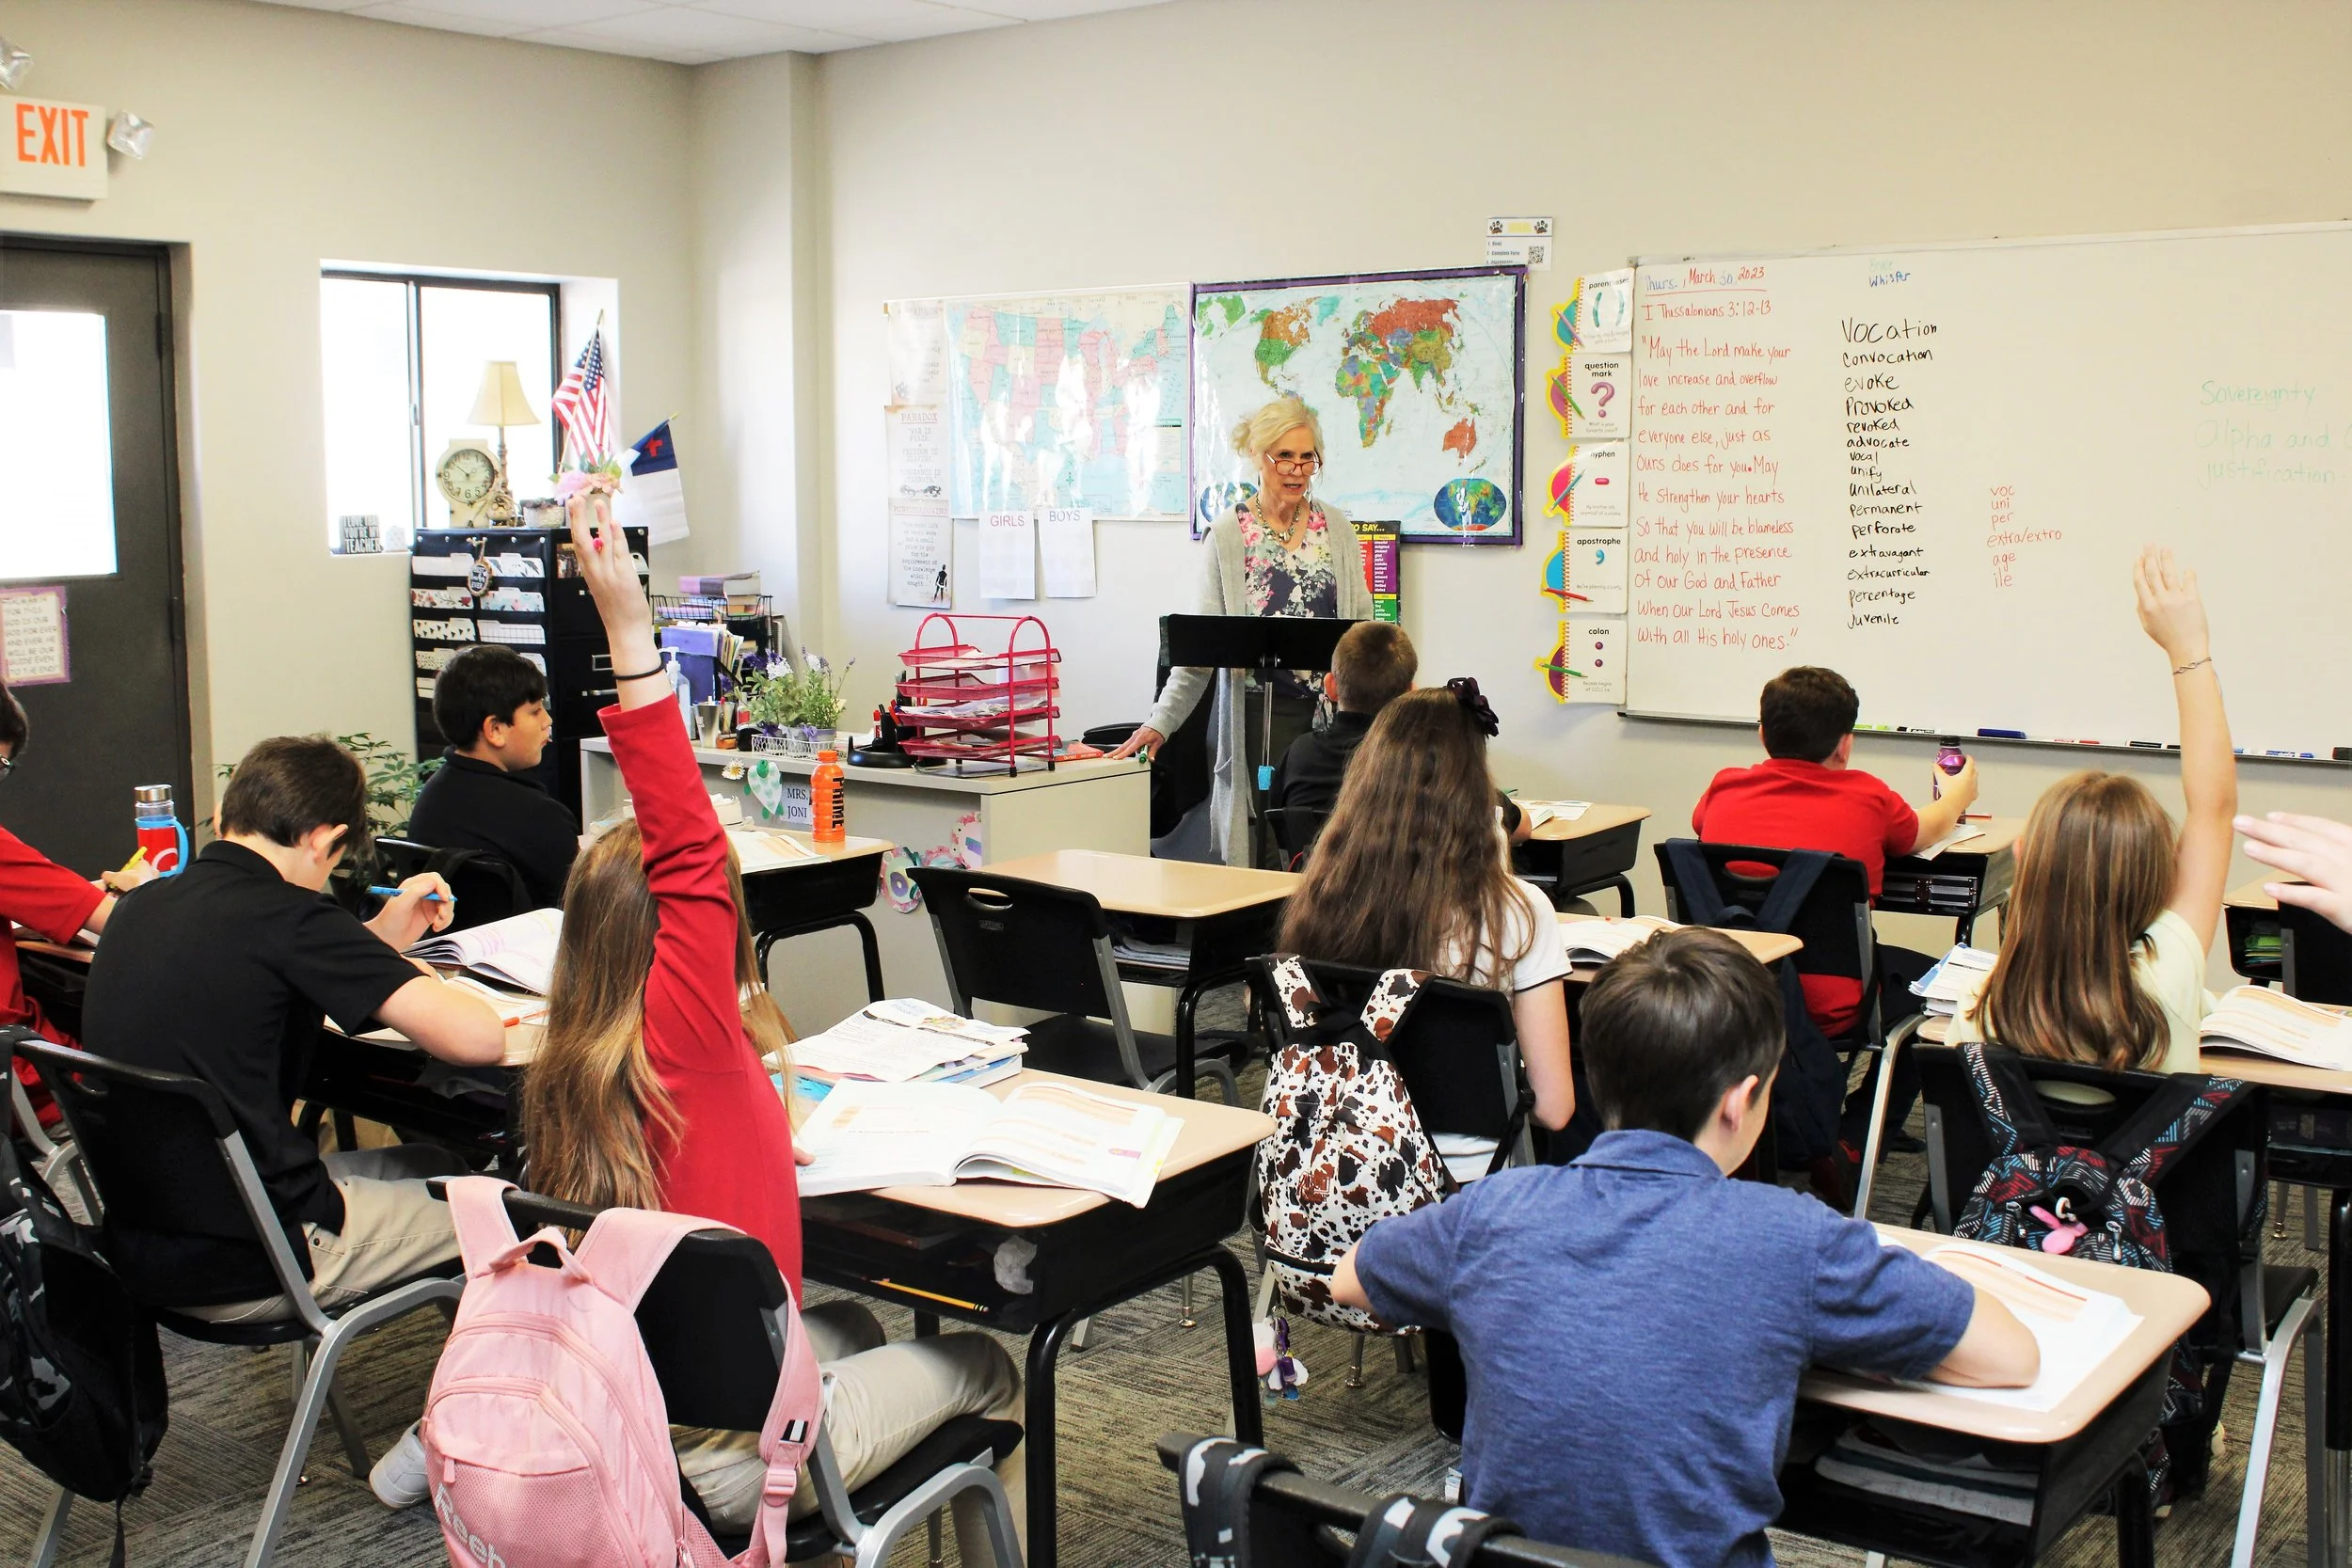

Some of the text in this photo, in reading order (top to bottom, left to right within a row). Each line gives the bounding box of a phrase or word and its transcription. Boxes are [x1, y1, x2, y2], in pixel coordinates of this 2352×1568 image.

[16, 103, 89, 166] EXIT
[1689, 267, 1716, 285] March
[1738, 266, 1765, 282] 2023
[1676, 338, 1700, 357] the
[1704, 335, 1729, 357] Lord
[1733, 341, 1766, 357] make
[1768, 345, 1792, 365] your
[1584, 361, 1620, 371] question
[1638, 368, 1779, 388] love increase and overflow
[1844, 372, 1900, 393] evoke
[1638, 394, 1776, 416] for each other and for
[900, 412, 938, 422] PARADOX
[1846, 418, 1900, 434] revoked
[1638, 426, 1772, 451] everyone else, just as
[1847, 435, 1911, 449] advocate
[1850, 451, 1879, 465] vocal
[1671, 453, 1700, 472] does
[1704, 453, 1724, 474] for
[1753, 454, 1779, 486] May
[1851, 466, 1883, 484] unify
[1638, 481, 1650, 502] He
[1716, 490, 1740, 513] your
[1745, 484, 1786, 505] hearts
[1990, 485, 2016, 497] voc
[1991, 497, 2010, 510] uni
[990, 515, 1025, 527] GIRLS
[1049, 510, 1081, 522] BOYS
[1991, 512, 2015, 531] per
[1654, 516, 1679, 537] that
[1686, 521, 1705, 545] you
[1708, 519, 1728, 537] will
[1731, 517, 1744, 536] be
[1748, 516, 1795, 535] blameless
[345, 537, 383, 553] TEACHER
[1577, 537, 1621, 546] apostrophe
[1634, 545, 1793, 570] and holy in the presence
[1993, 552, 2017, 573] age
[1684, 570, 1708, 590] God
[1713, 572, 1740, 592] and
[1740, 570, 1783, 590] Father
[1993, 567, 2013, 588] ile
[1637, 599, 1669, 617] When
[1698, 598, 1722, 619] Lord
[1725, 599, 1757, 619] Jesus
[1673, 629, 1691, 644] all
[1697, 626, 1718, 647] His
[1723, 626, 1748, 654] holy
[787, 787, 809, 800] MRS.
[831, 776, 846, 830] PRIME
[787, 805, 808, 818] JONI
